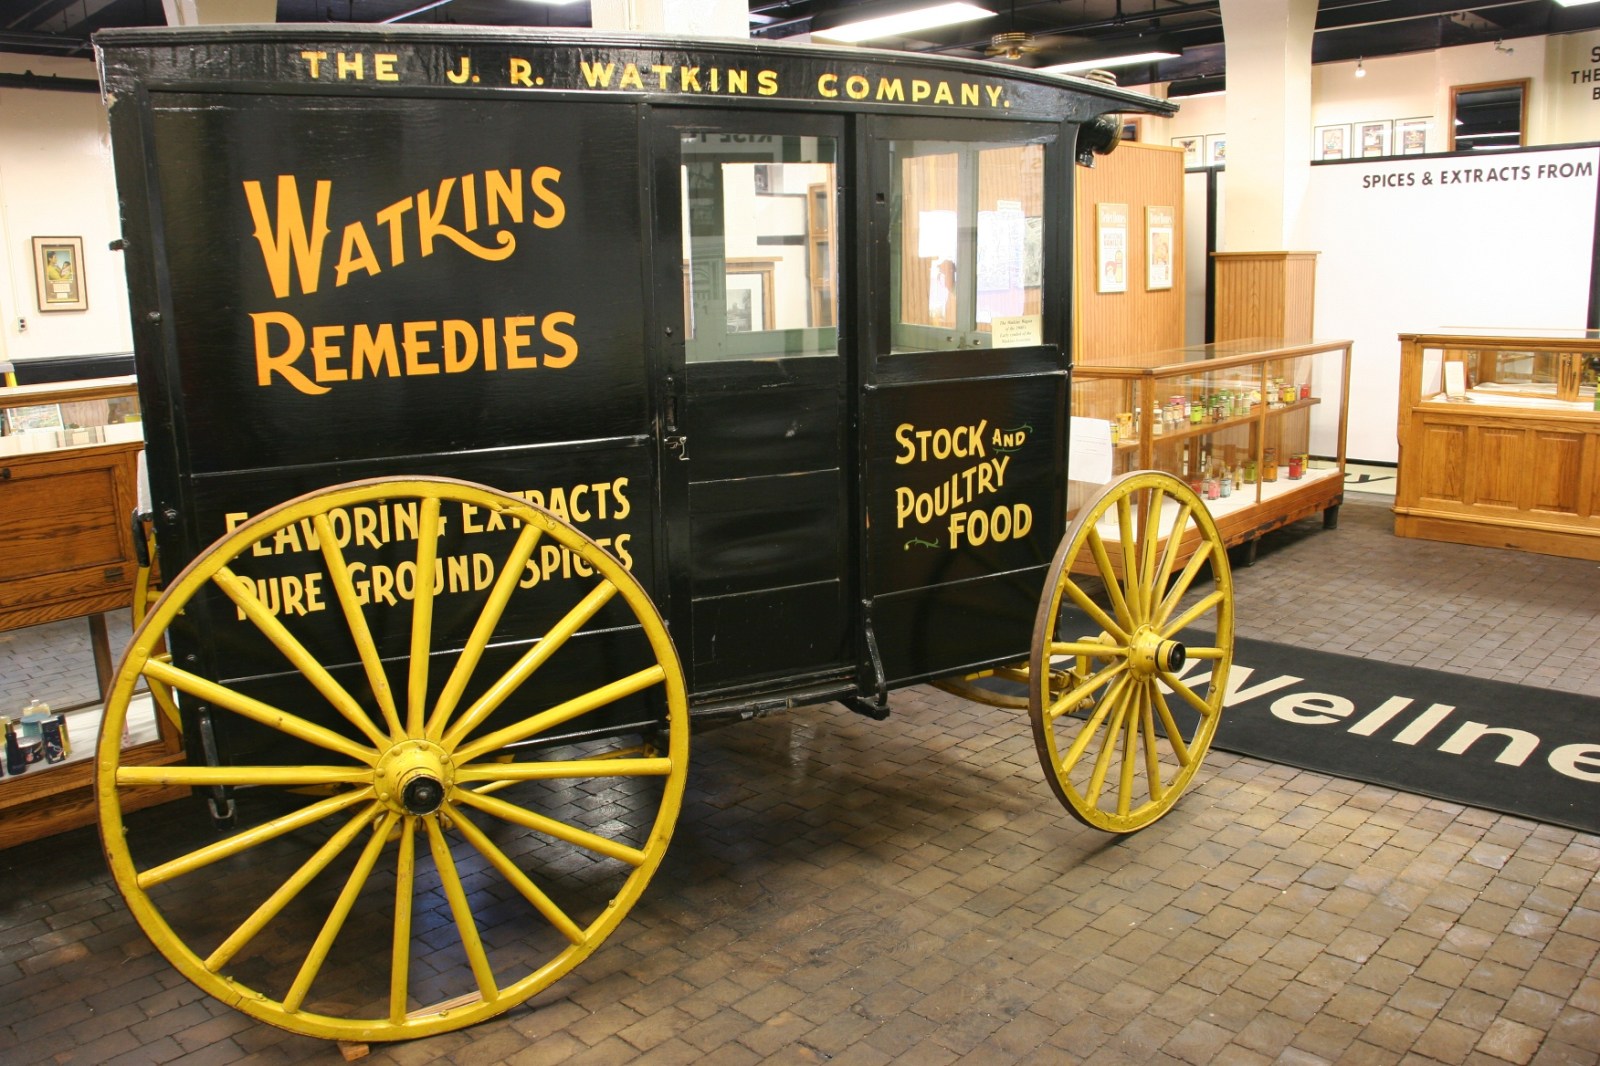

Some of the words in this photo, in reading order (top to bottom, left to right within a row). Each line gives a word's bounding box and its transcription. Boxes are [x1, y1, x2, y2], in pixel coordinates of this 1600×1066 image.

[301, 51, 400, 82] THE
[446, 57, 481, 85] J.
[509, 58, 544, 87] R.
[579, 62, 778, 96] WATKINS
[817, 73, 1011, 108] COMPANY.
[1362, 172, 1416, 189] SPICES
[1421, 171, 1433, 186] &
[1440, 165, 1531, 185] EXTRACTS
[1537, 161, 1593, 179] FROM
[242, 166, 566, 299] WATKINS
[248, 311, 579, 395] REMEDIES
[895, 419, 988, 465] STOCK
[992, 428, 1026, 447] AND
[895, 455, 1011, 529] POULTRY
[948, 503, 1033, 550] FOOD
